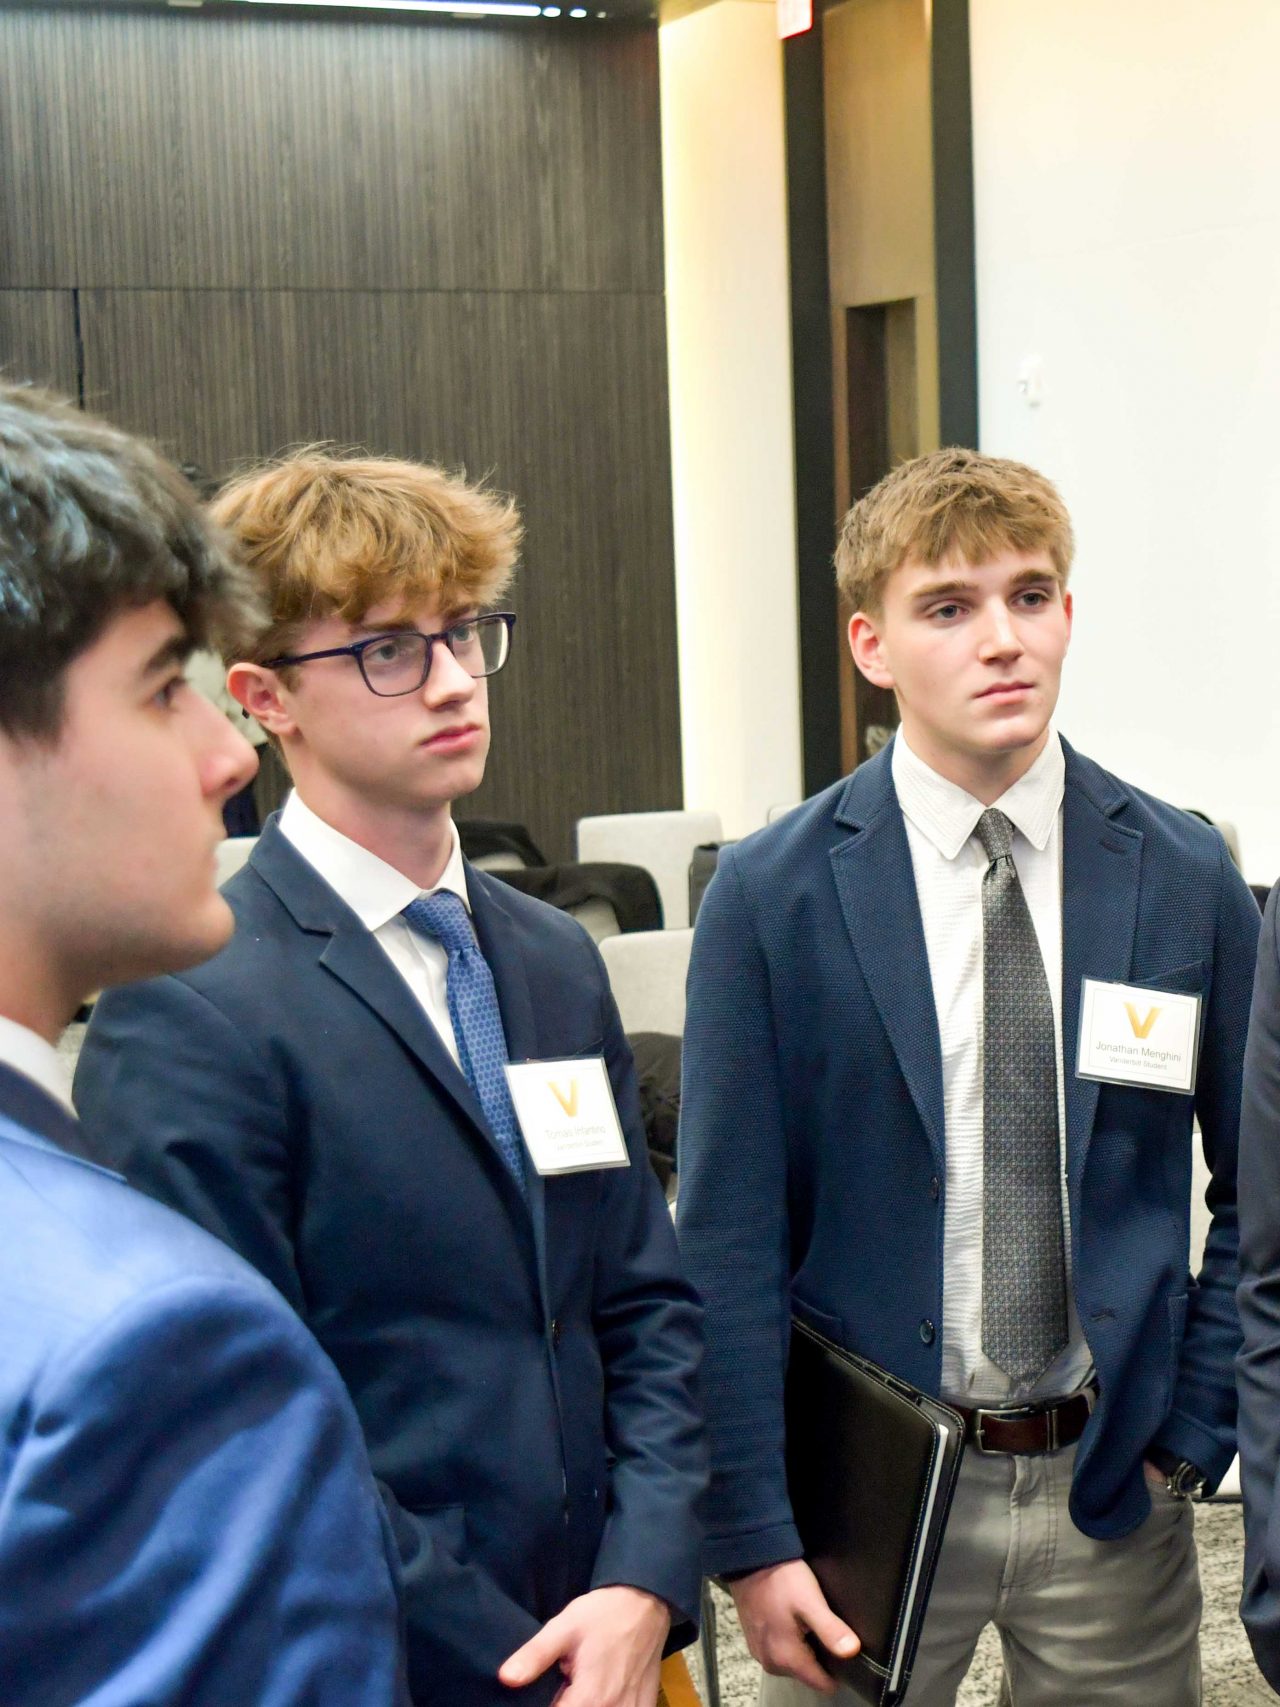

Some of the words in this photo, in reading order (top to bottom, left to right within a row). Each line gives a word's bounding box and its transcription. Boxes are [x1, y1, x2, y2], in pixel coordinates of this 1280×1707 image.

[1122, 1001, 1163, 1039] V
[1096, 1041, 1139, 1055] Jonathan
[1141, 1047, 1182, 1062] Menghini
[546, 1076, 579, 1118] V
